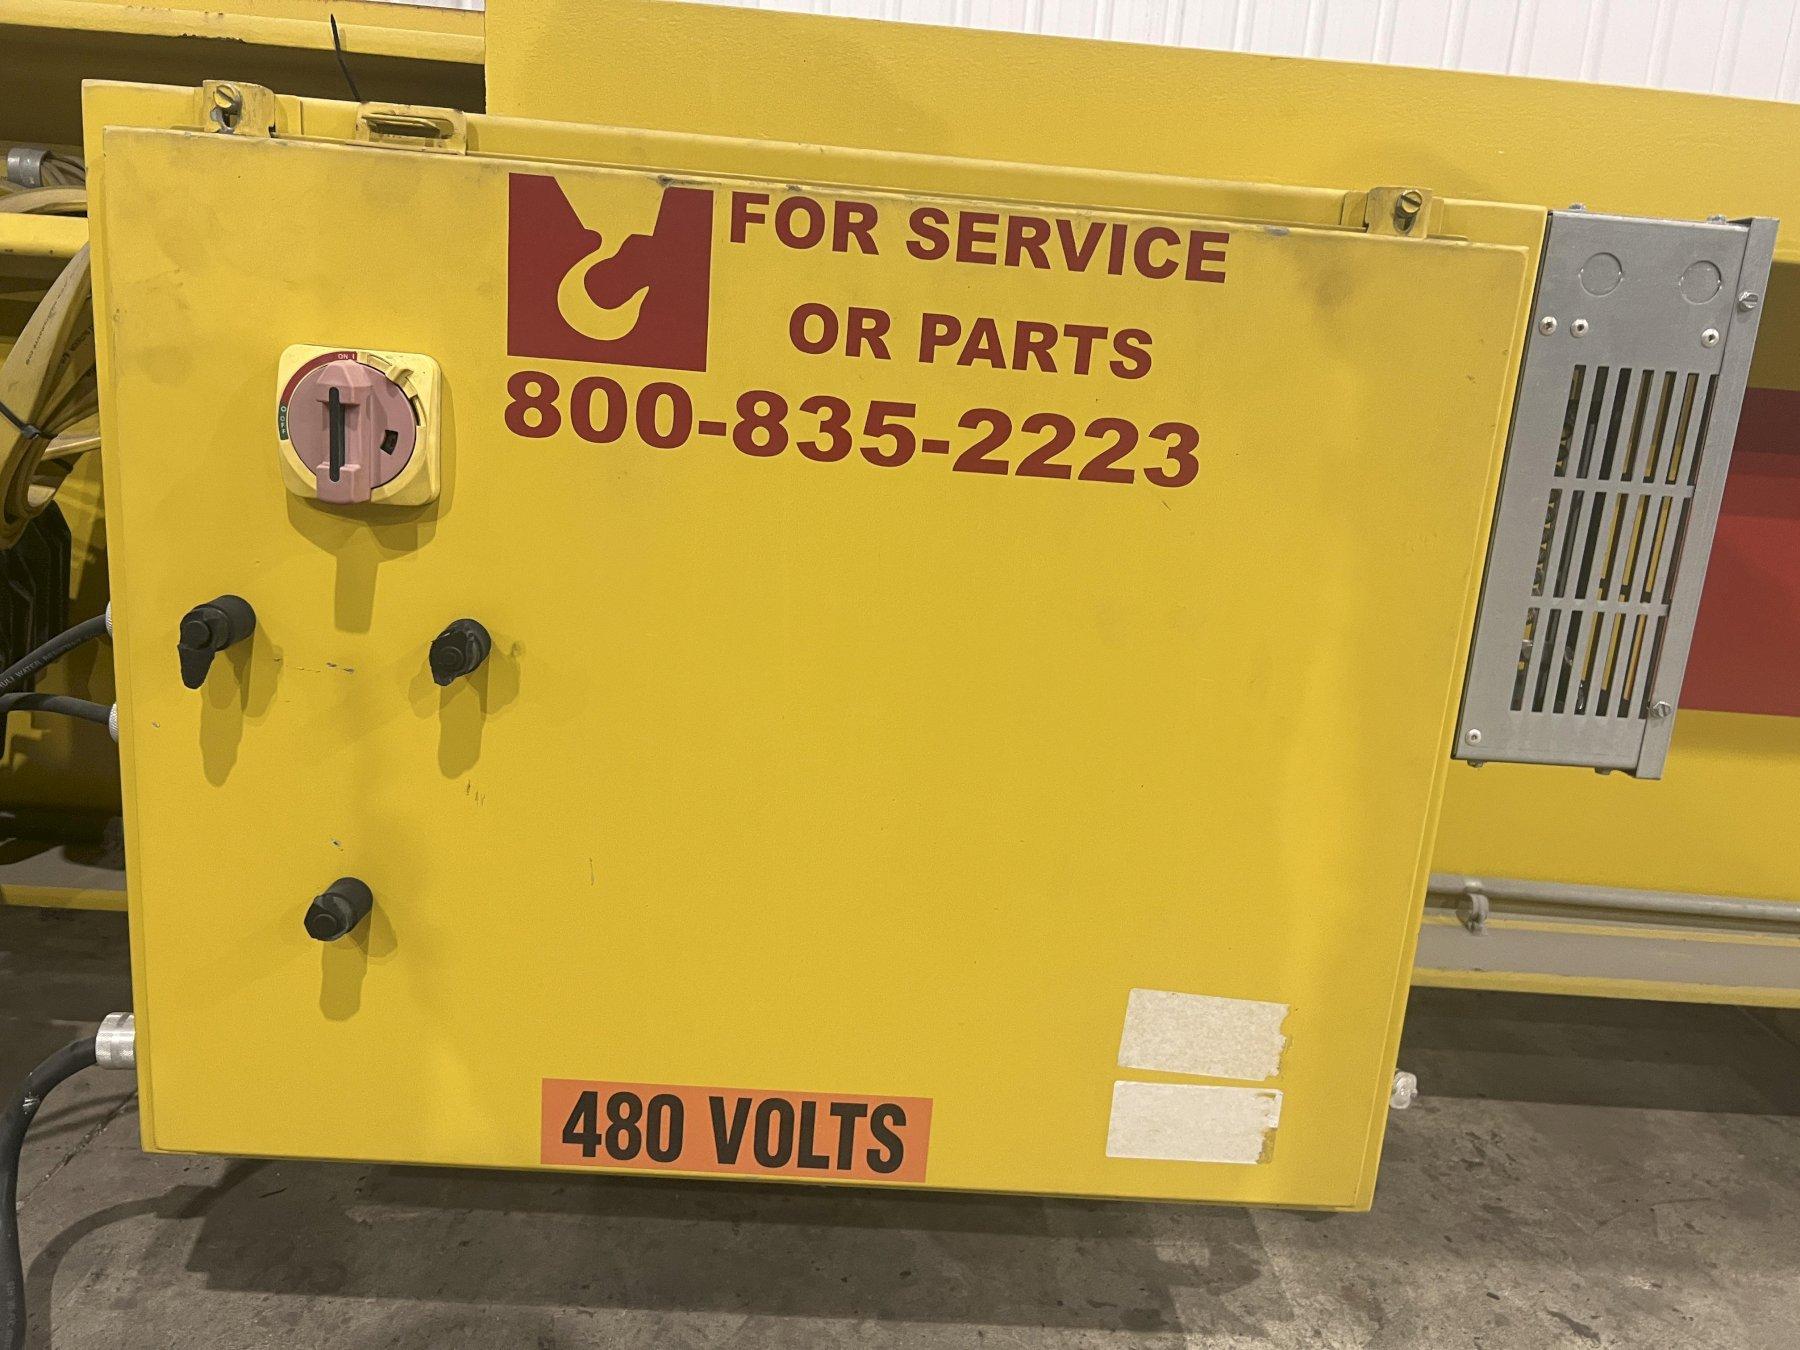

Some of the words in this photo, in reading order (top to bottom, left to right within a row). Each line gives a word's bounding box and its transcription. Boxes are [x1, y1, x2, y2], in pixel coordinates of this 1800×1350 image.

[731, 190, 880, 256] FOR
[905, 207, 1230, 284] SERVICE
[789, 302, 892, 360] OR
[919, 312, 1153, 380] PARTS
[505, 370, 1200, 488] 800-835-2223
[562, 1090, 685, 1164] 480
[708, 1095, 907, 1174] VOLTS
